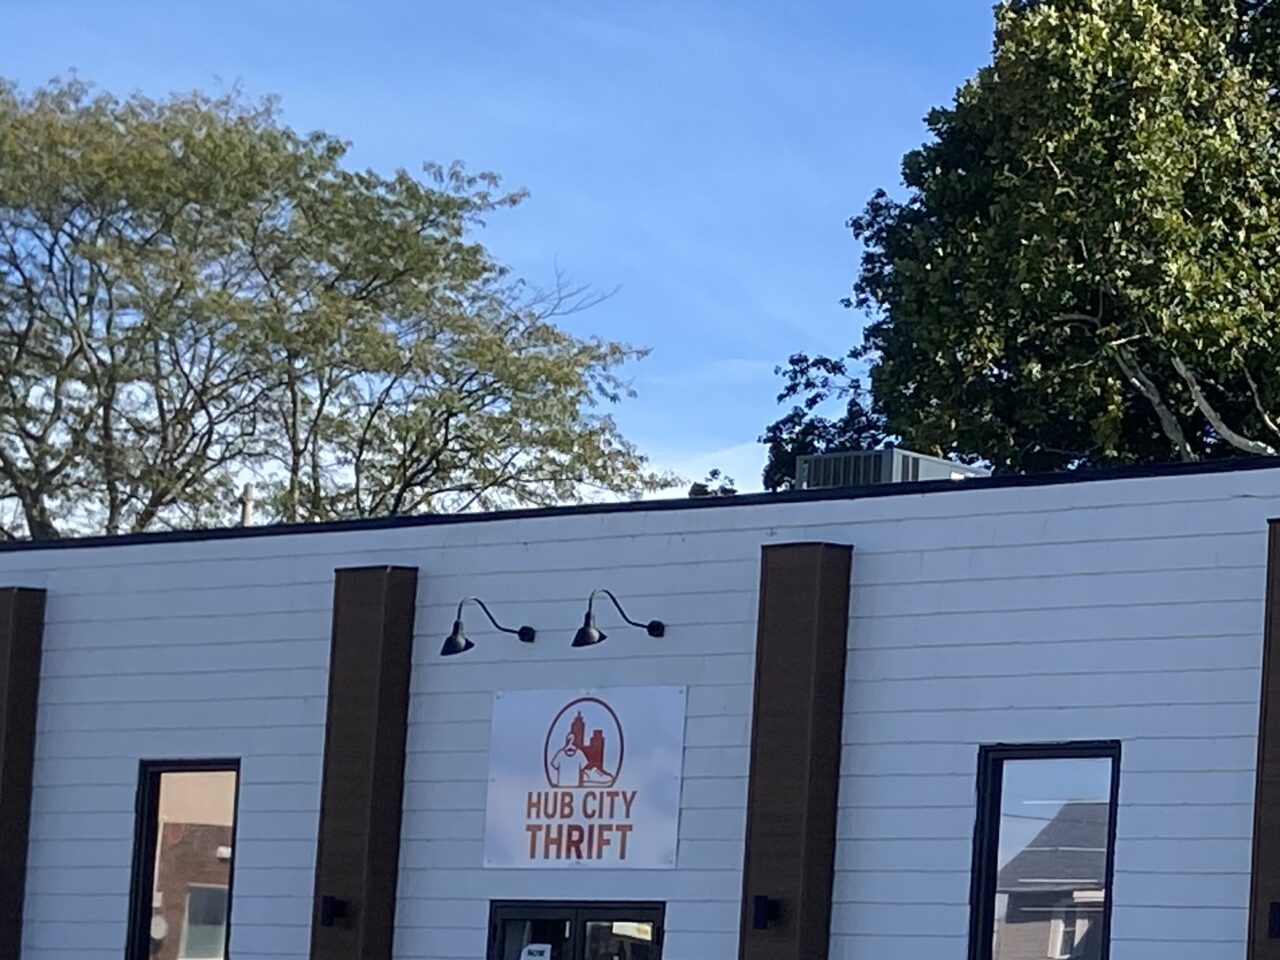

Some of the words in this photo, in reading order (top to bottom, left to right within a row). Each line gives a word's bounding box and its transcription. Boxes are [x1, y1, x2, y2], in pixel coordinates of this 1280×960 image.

[526, 791, 574, 819] HUB
[582, 790, 637, 819] CITY
[525, 824, 633, 860] THRIFT
